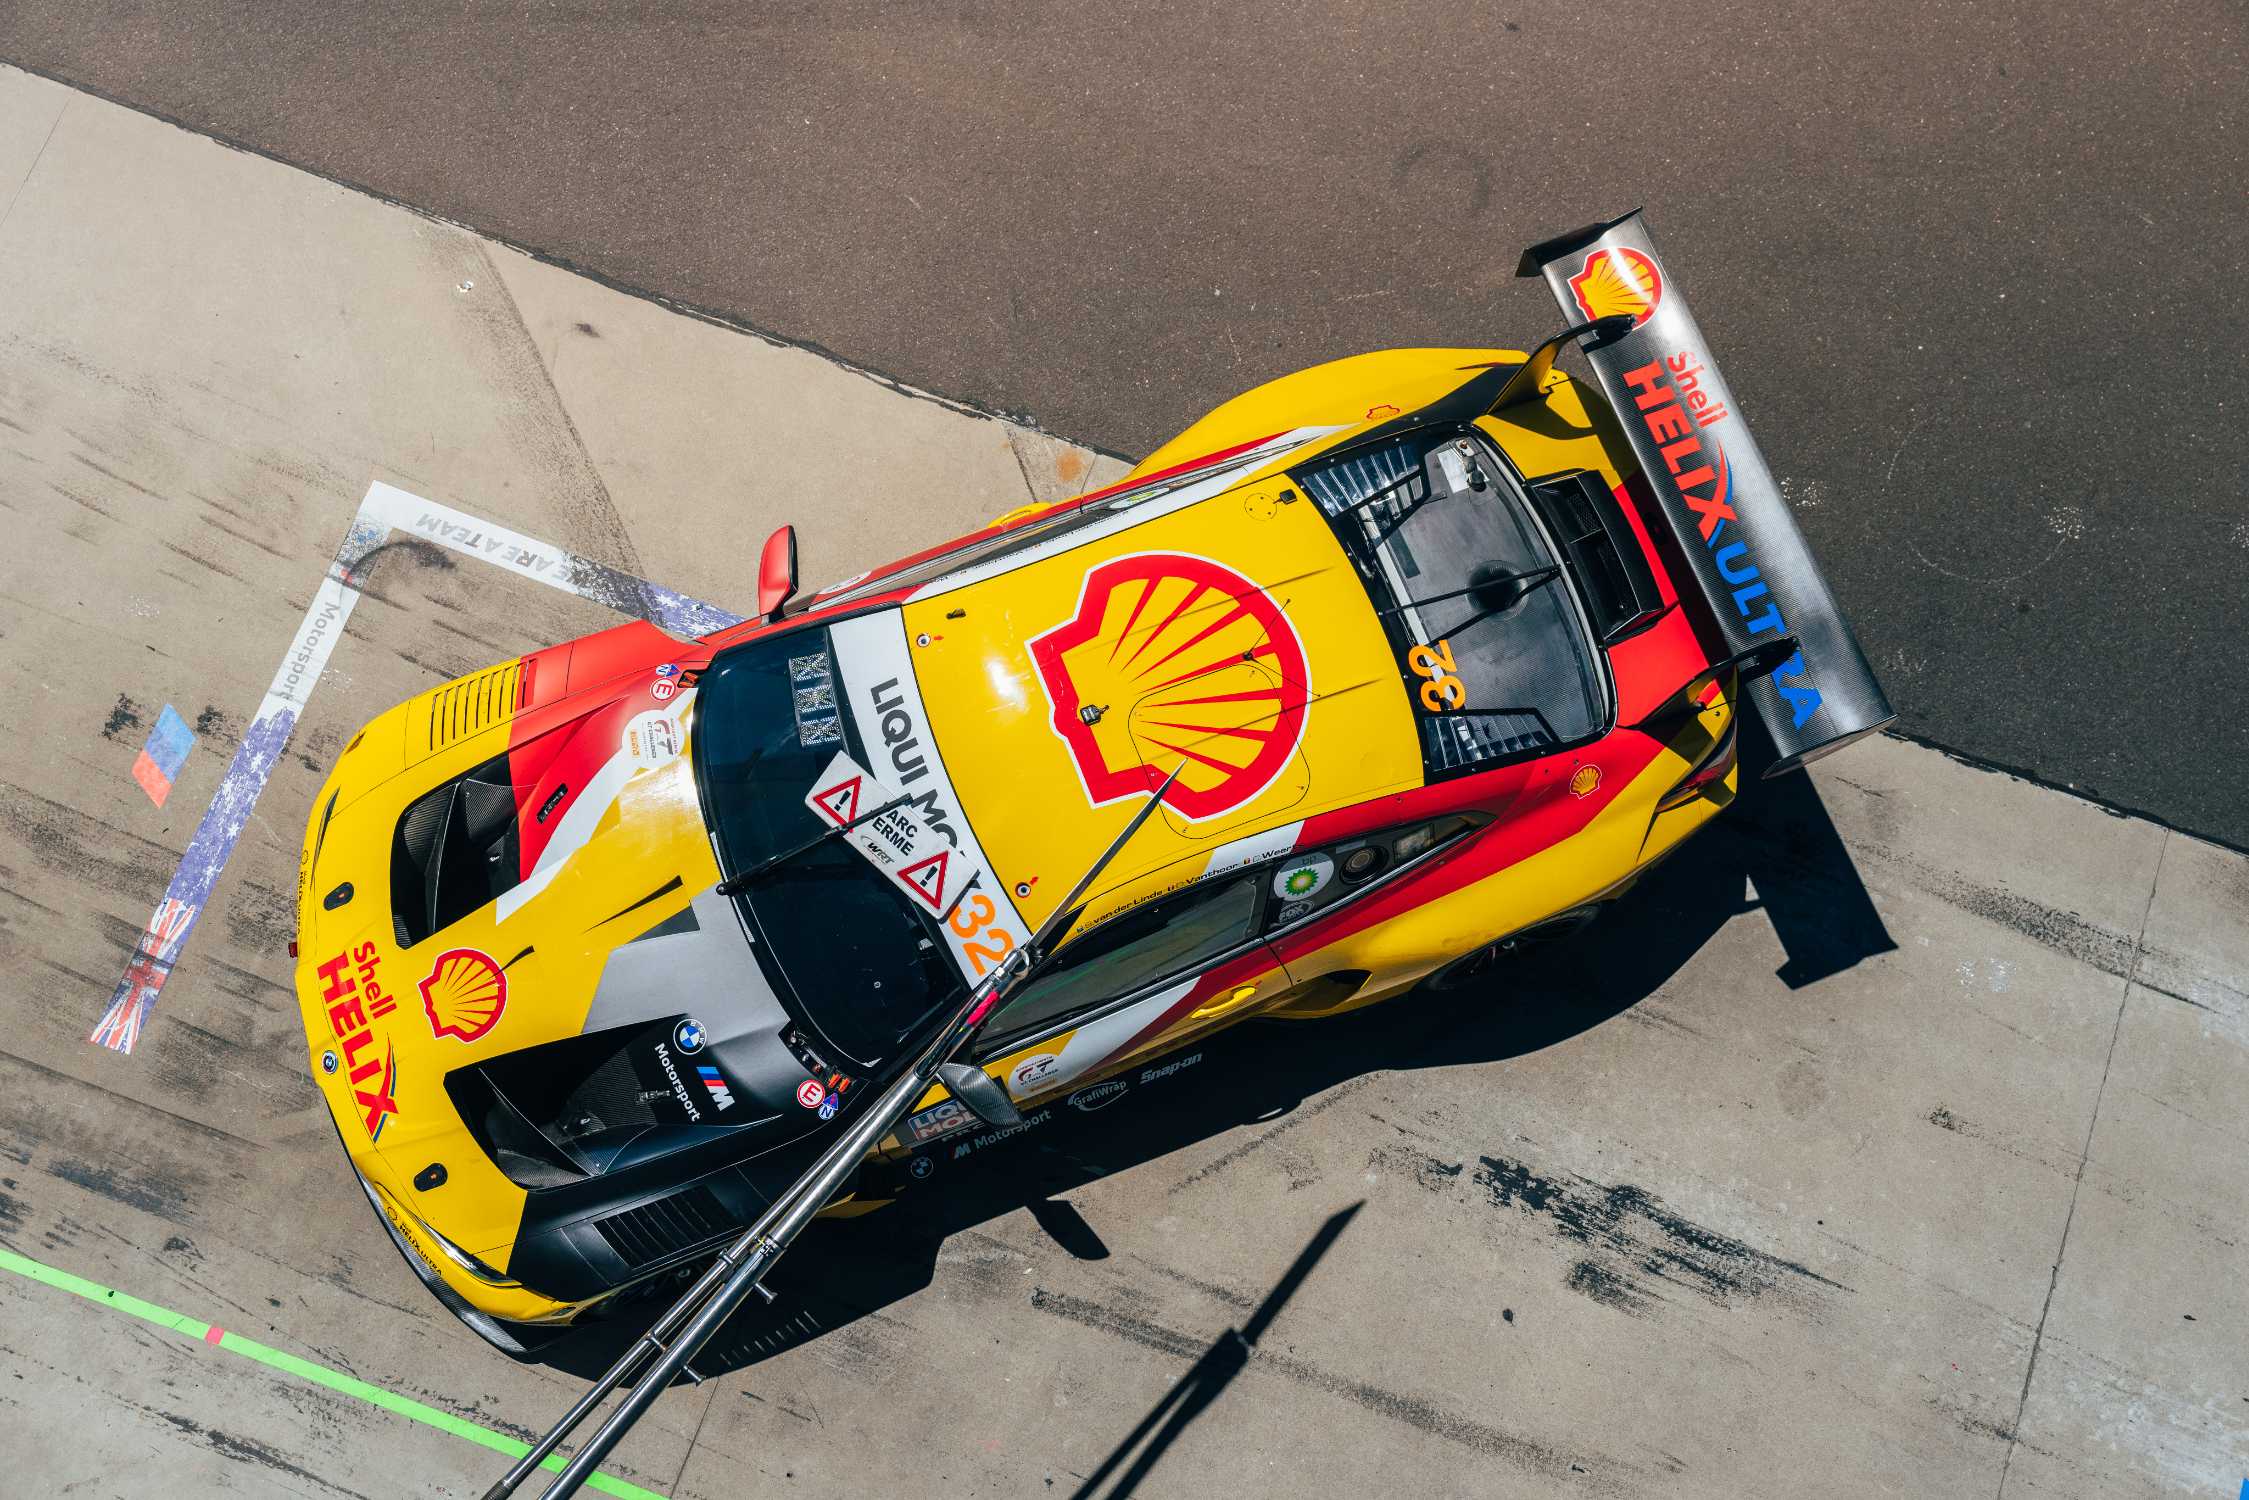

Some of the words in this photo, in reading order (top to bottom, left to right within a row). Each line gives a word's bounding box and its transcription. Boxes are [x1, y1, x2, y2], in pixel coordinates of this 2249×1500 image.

[1667, 351, 1728, 429] Shell
[1622, 359, 1738, 549] HELIX
[416, 513, 483, 548] TEAM
[485, 536, 505, 552] A
[501, 546, 554, 572] ARE
[277, 601, 341, 701] Motorsport
[1408, 639, 1466, 712] 32
[870, 677, 929, 786] LIQUI
[872, 816, 914, 857] ERME
[886, 808, 918, 839] ARC
[948, 895, 1014, 976] 32
[354, 941, 398, 1020] Shell
[317, 950, 399, 1144] HELIX
[654, 1042, 701, 1122] Motorsport
[919, 1113, 978, 1140] MOL
